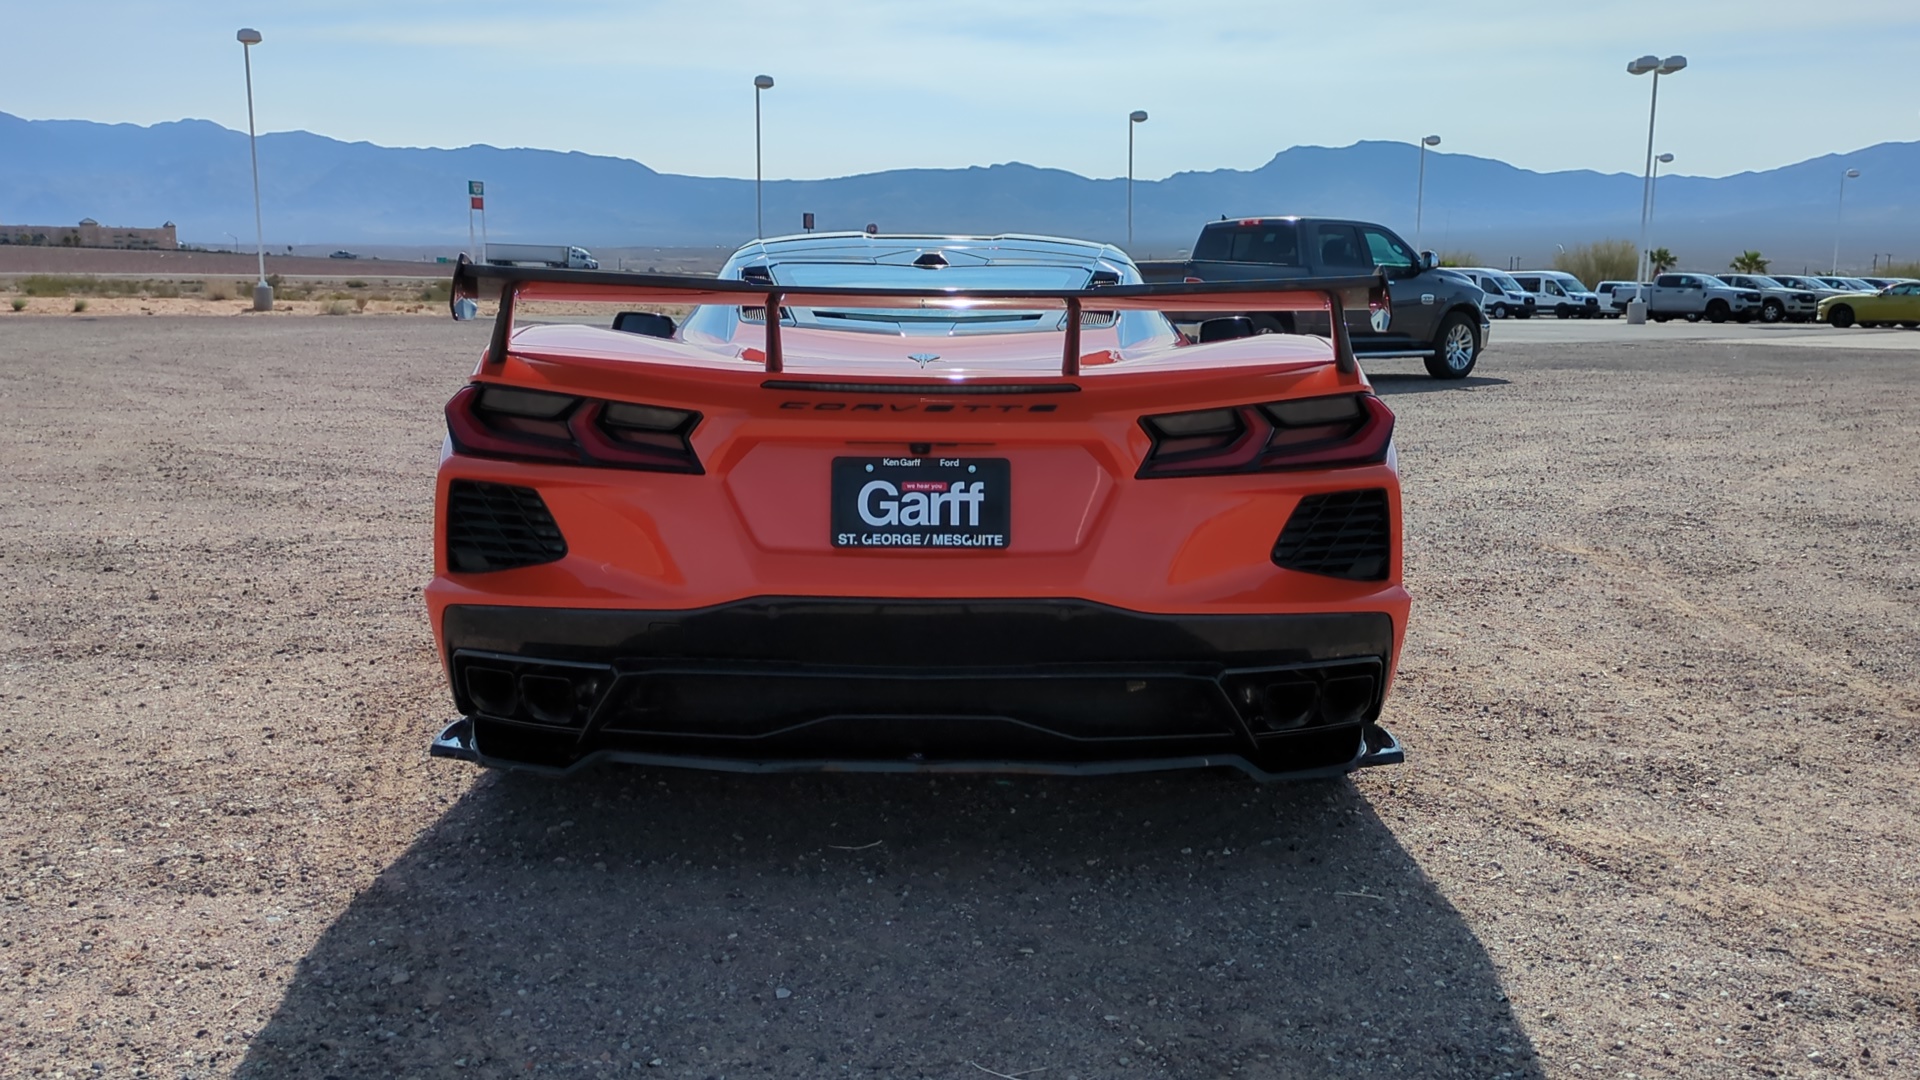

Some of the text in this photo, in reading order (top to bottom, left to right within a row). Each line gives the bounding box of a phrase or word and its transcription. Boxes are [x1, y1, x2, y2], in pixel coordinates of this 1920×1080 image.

[779, 401, 1058, 413] CORVETTE
[883, 458, 921, 466] Ken Garff
[940, 459, 959, 467] Ford
[857, 480, 984, 526] Garff
[838, 534, 857, 545] ST.
[862, 534, 921, 545] GEORGE
[932, 534, 1003, 546] MESQUITE
